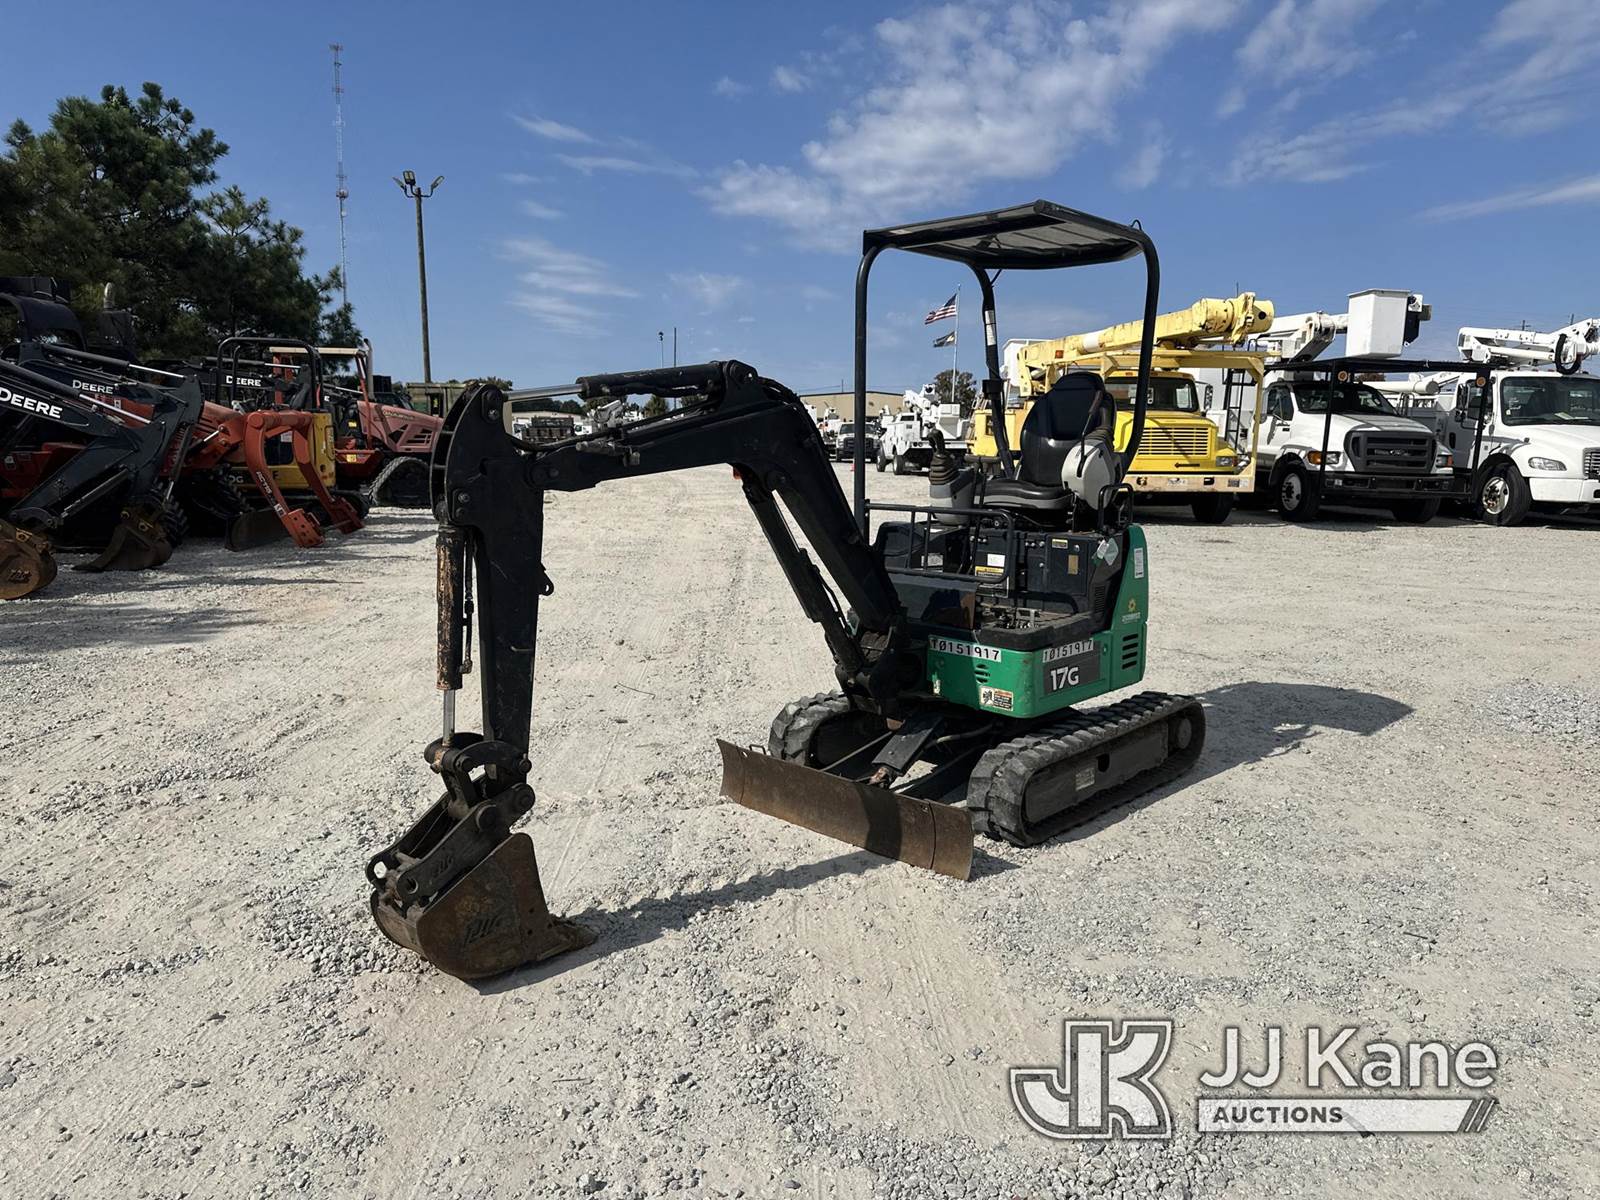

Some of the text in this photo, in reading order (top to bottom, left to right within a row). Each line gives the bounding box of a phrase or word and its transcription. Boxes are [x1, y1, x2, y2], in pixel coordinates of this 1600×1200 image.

[72, 379, 114, 394] DEERE
[0, 386, 63, 419] DEERE
[1043, 639, 1093, 661] 10151917
[1050, 666, 1079, 691] 17G
